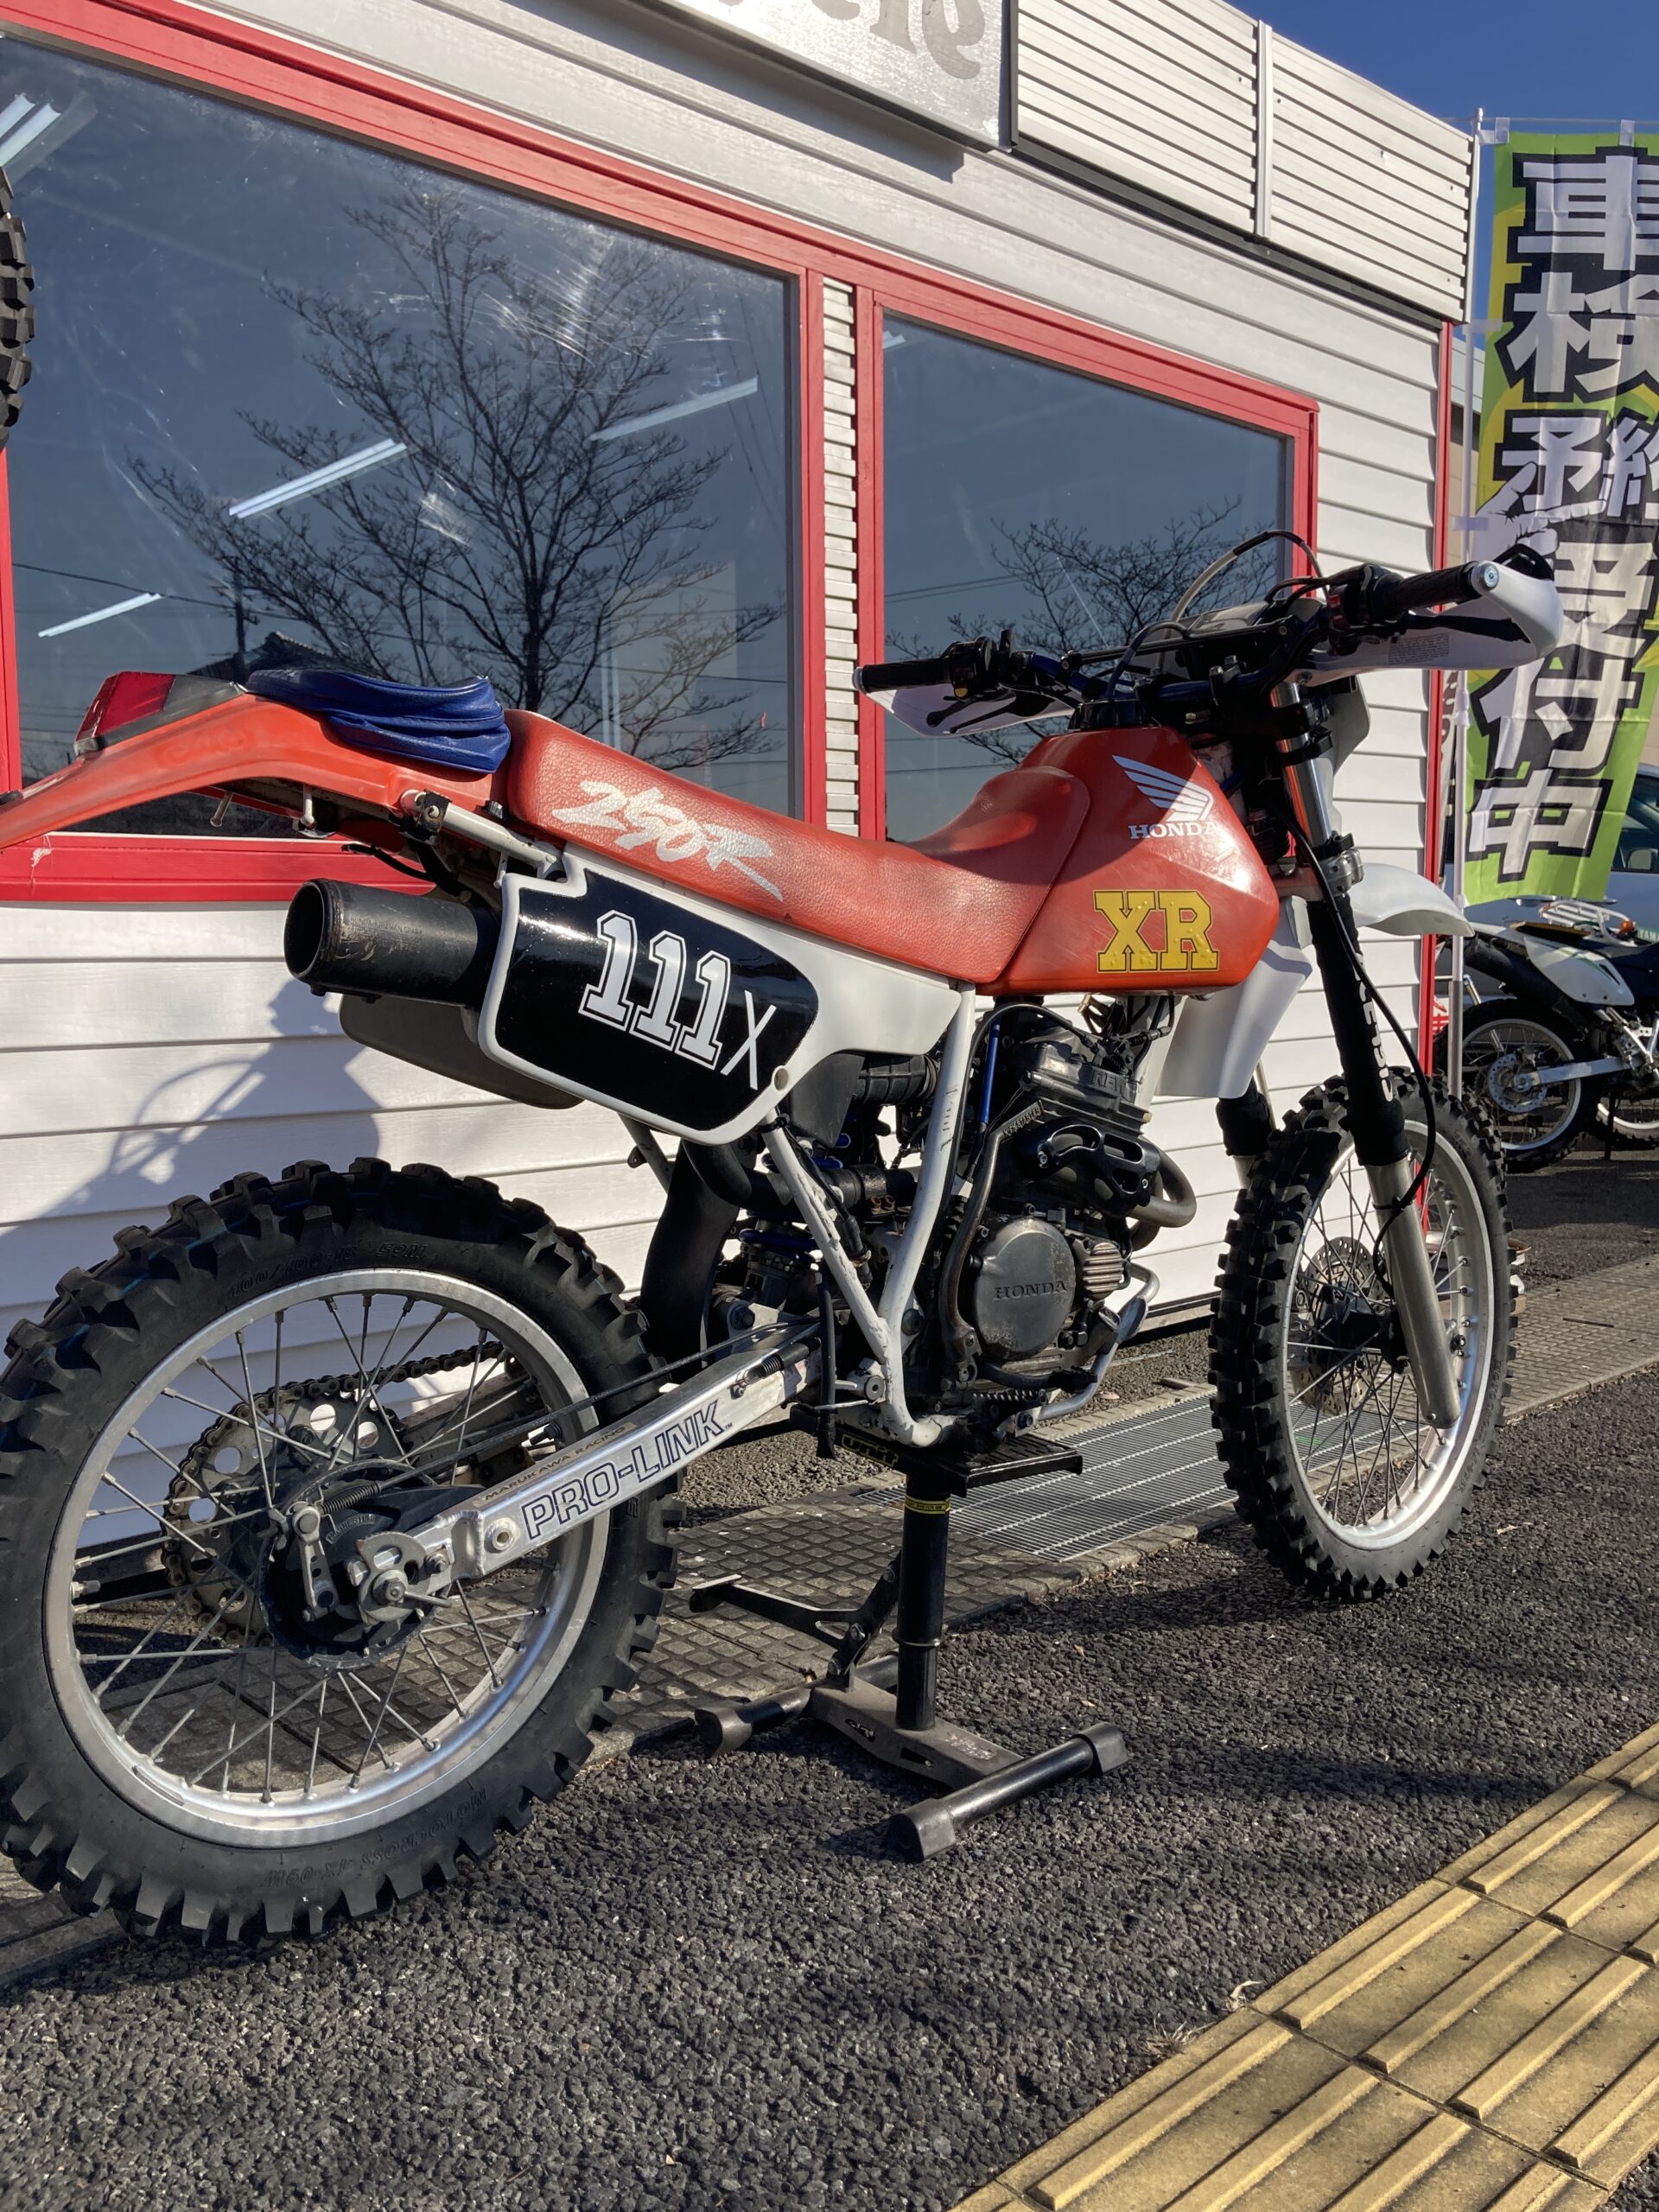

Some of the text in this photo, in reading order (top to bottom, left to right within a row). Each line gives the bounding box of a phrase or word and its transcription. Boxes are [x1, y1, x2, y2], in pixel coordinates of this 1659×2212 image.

[552, 780, 785, 902] 250R
[1128, 822, 1220, 840] HONDA
[1093, 889, 1219, 973] XR
[995, 1281, 1068, 1300] HONDA
[485, 1427, 626, 1501] MARUKAWA RACING
[521, 1400, 725, 1540] PRO-LINK
